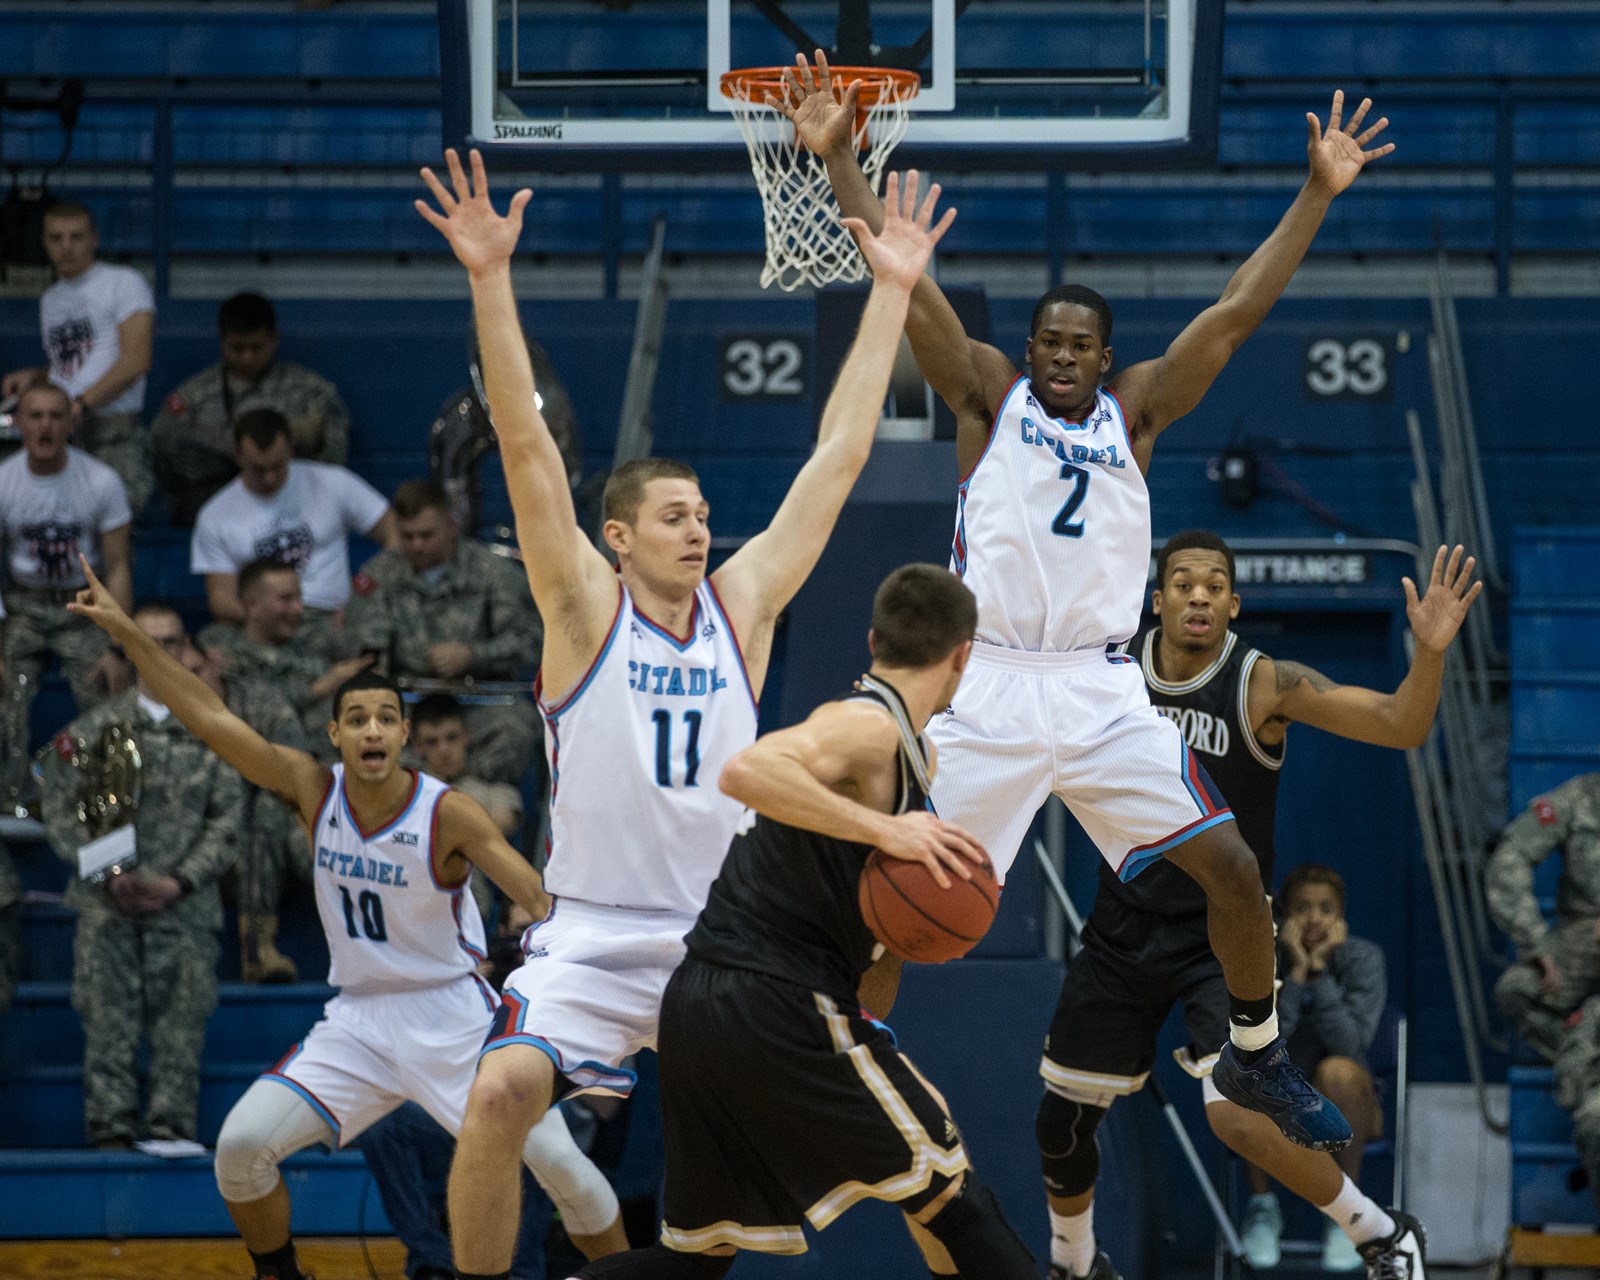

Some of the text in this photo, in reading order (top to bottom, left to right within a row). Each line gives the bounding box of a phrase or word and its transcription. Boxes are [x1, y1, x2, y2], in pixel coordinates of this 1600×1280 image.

[494, 124, 562, 139] SPALDING
[725, 340, 802, 395] 32
[1306, 340, 1386, 395] 33
[1051, 462, 1090, 539] 2
[1235, 555, 1365, 582] ITTANCE
[652, 708, 702, 788] 11
[318, 846, 409, 887] CITADEL
[338, 884, 388, 942] 10
